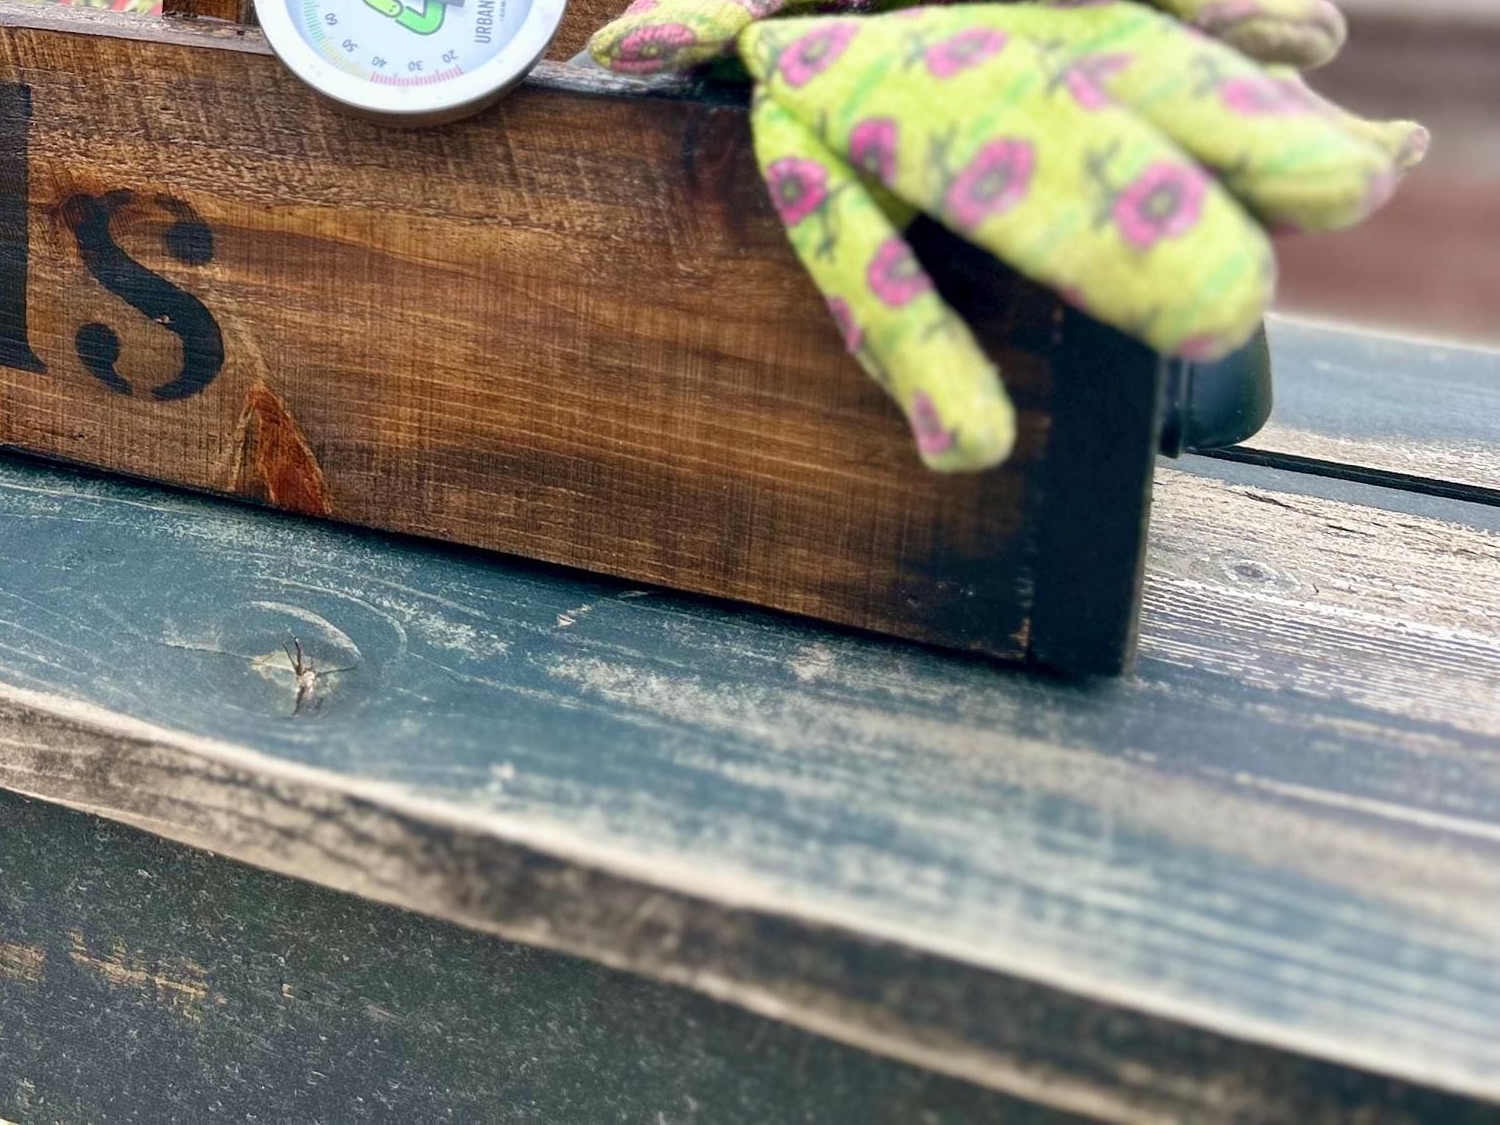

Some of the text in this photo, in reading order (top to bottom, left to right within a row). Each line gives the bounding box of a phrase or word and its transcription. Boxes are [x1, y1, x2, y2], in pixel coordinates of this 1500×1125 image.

[324, 13, 338, 26] 60
[474, 0, 496, 44] URBAN
[342, 39, 358, 52] 50
[372, 56, 387, 67] 40
[442, 49, 458, 63] 20
[407, 60, 423, 71] 30
